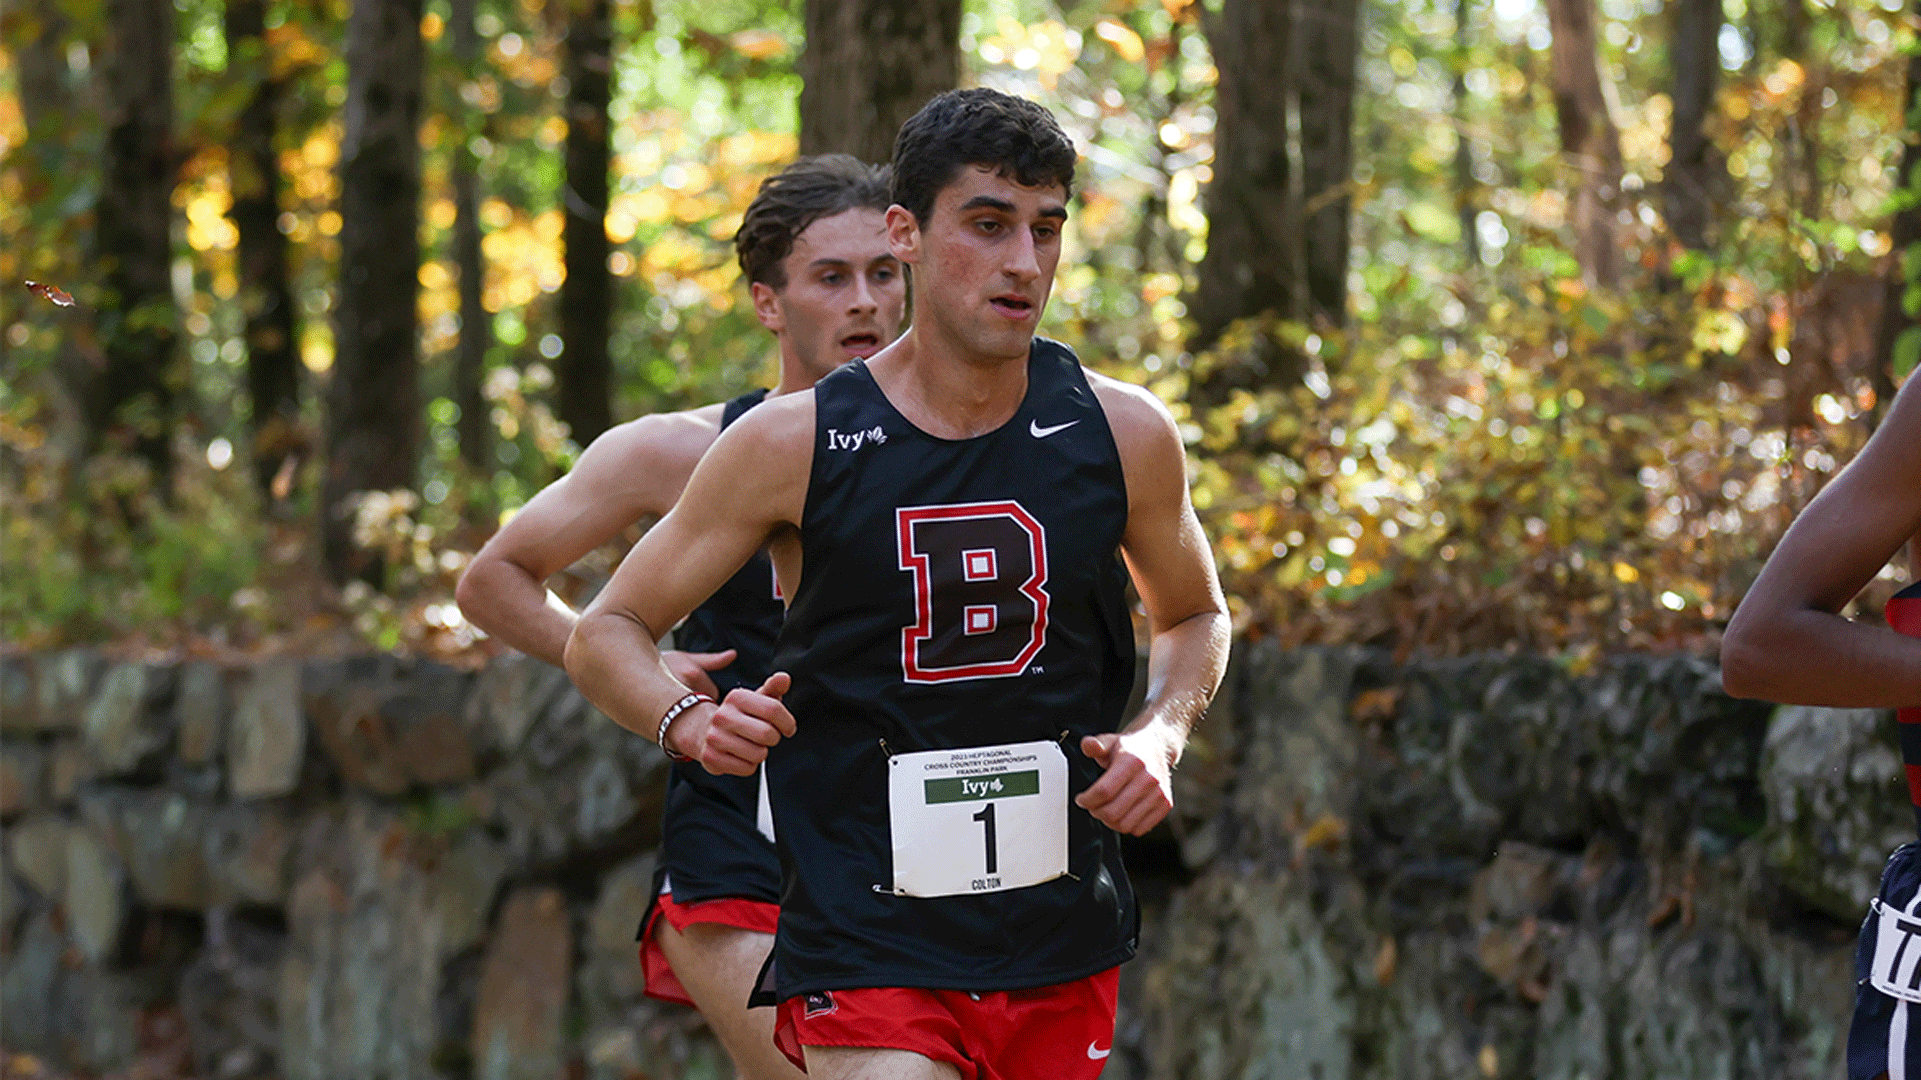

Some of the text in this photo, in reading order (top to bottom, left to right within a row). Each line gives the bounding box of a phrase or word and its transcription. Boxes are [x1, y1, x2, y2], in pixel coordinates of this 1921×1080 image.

[827, 428, 865, 451] Ivy
[895, 499, 1051, 685] B
[924, 755, 1037, 771] CROSS COUNTRY CHAMPIONSHIPS
[990, 765, 1008, 773] PARK
[962, 778, 989, 797] Ivy
[973, 803, 998, 874] 1
[971, 878, 1002, 891] COLTON
